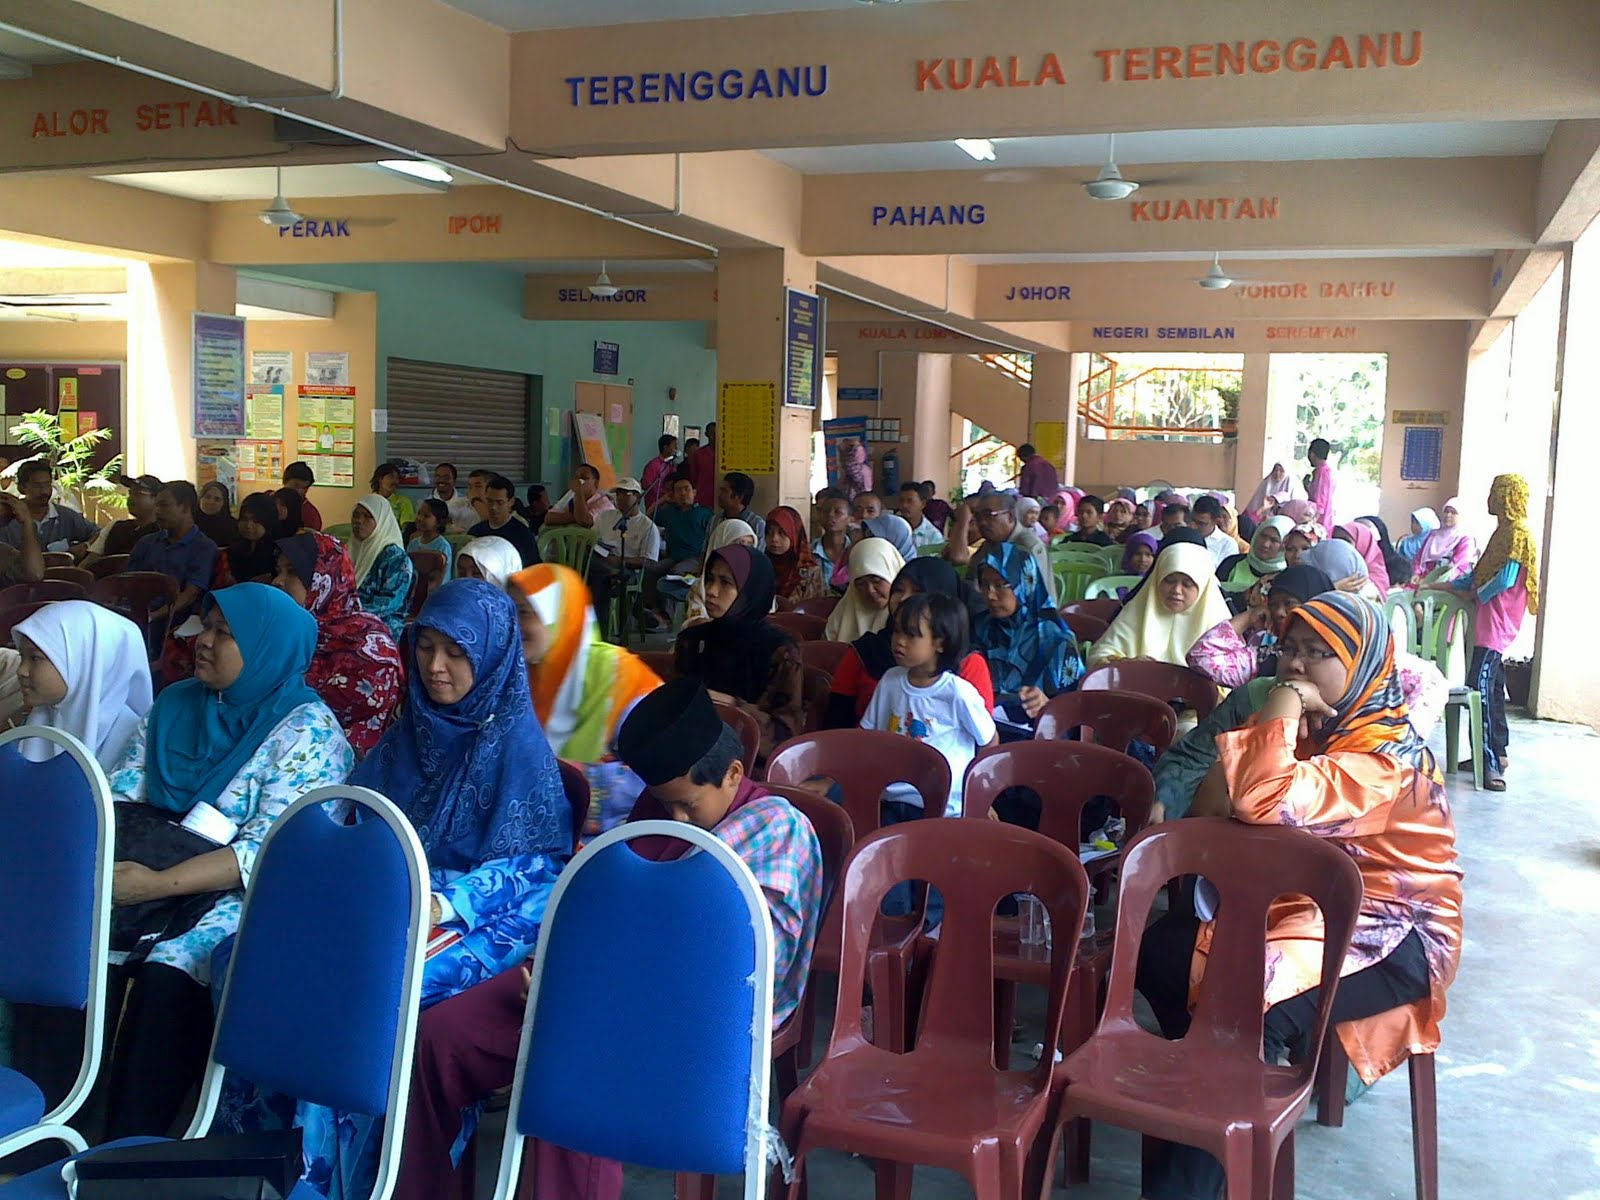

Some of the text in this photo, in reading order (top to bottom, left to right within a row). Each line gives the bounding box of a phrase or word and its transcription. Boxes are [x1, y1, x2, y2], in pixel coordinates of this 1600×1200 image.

[916, 31, 1422, 92] KUALA TERENGGANU
[565, 65, 828, 106] TERENGGANU
[31, 100, 238, 138] ALOR SETAR
[872, 204, 987, 227] PAHANG
[1130, 197, 1280, 222] KUANTAN
[278, 219, 350, 238] PERAK
[448, 214, 502, 236] IPOH
[1006, 285, 1071, 301] JOHOR
[1235, 283, 1309, 300] JOHOR
[858, 327, 908, 340] KUALA
[1093, 326, 1236, 340] NEGERI SEMBILAN
